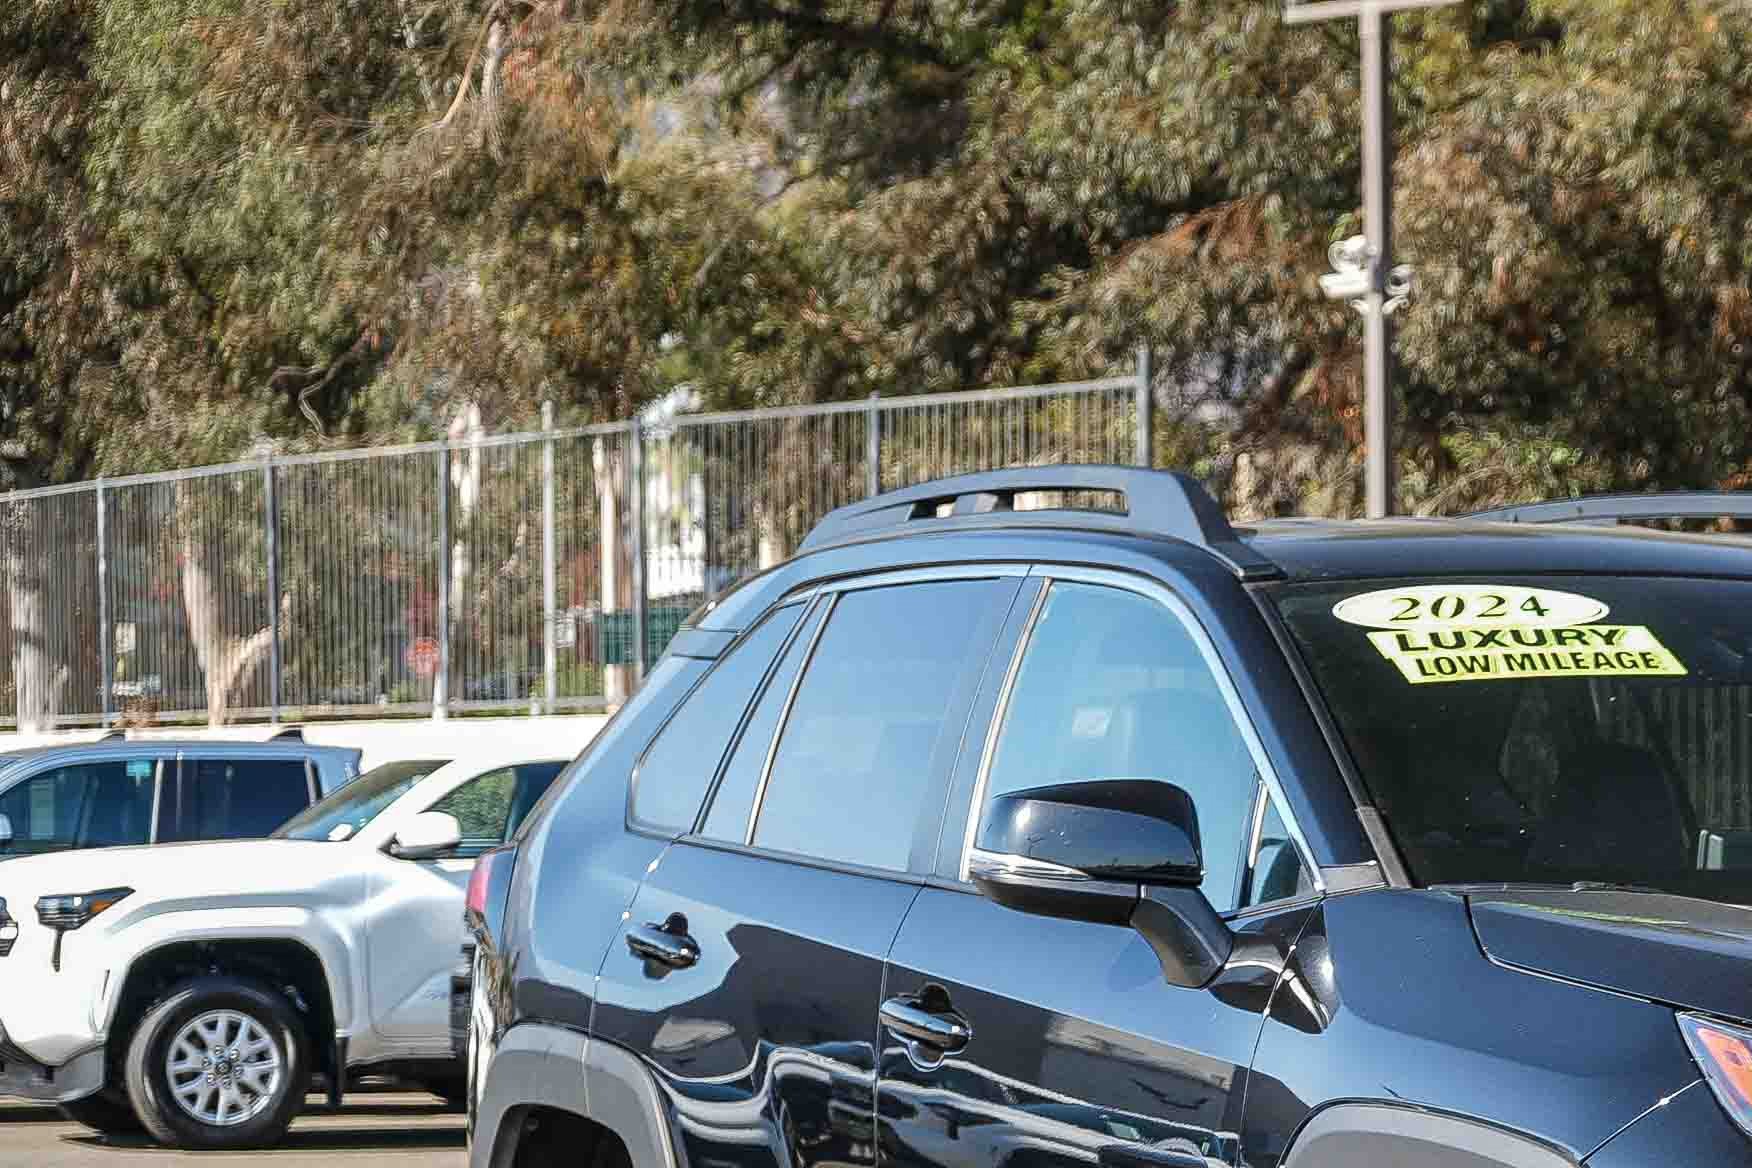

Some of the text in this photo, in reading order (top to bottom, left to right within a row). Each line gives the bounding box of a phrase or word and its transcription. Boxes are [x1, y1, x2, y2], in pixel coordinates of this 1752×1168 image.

[1389, 594, 1549, 621] 2024
[1396, 628, 1625, 652] LUXURY
[1415, 650, 1661, 678] LOW MILEAGE
